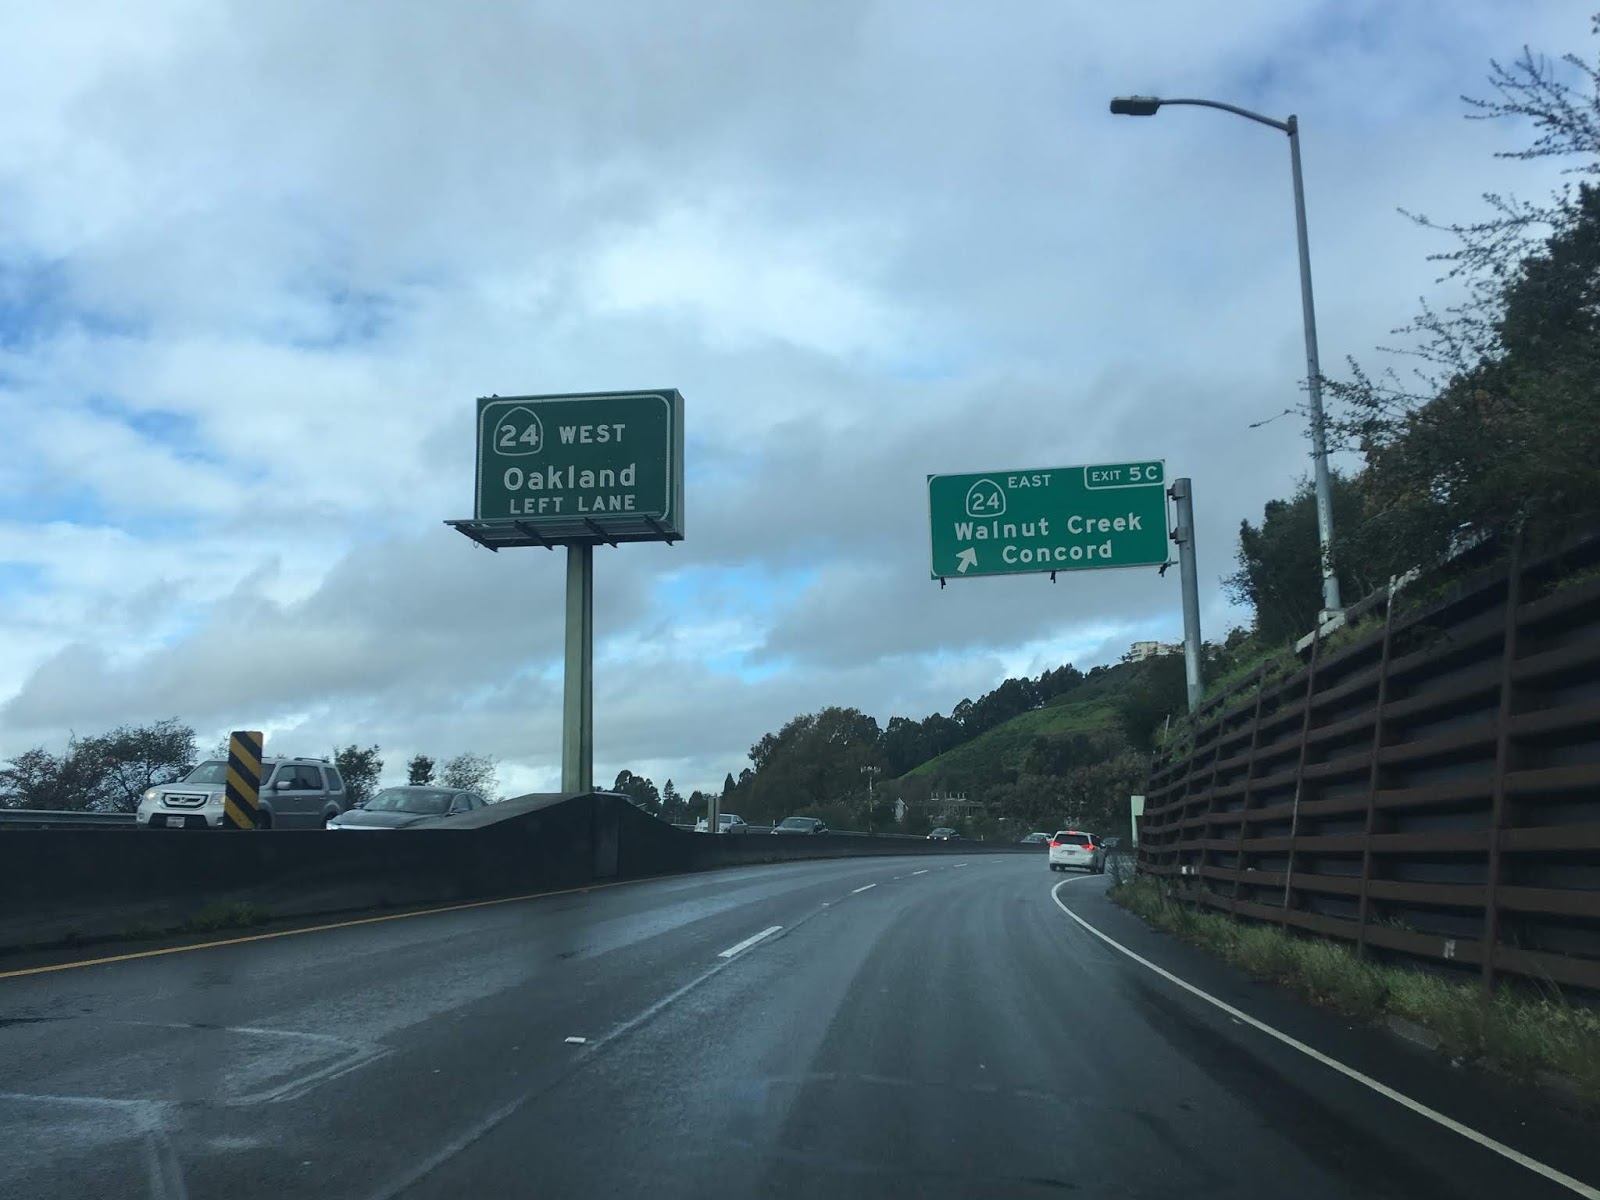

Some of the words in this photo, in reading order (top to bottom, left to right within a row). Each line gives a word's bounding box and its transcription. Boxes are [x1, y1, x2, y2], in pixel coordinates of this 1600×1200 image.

[499, 423, 539, 447] 24
[559, 424, 626, 444] WEST
[503, 463, 636, 490] Oakland
[1008, 474, 1051, 489] EAST
[1092, 470, 1121, 482] EXIT
[1129, 466, 1158, 481] 5C
[510, 497, 563, 514] LEFT
[578, 495, 636, 512] LANE
[972, 492, 1000, 511] 24
[954, 517, 1050, 541] Walnut
[1067, 512, 1142, 535] Creek
[1002, 540, 1113, 564] Concord
